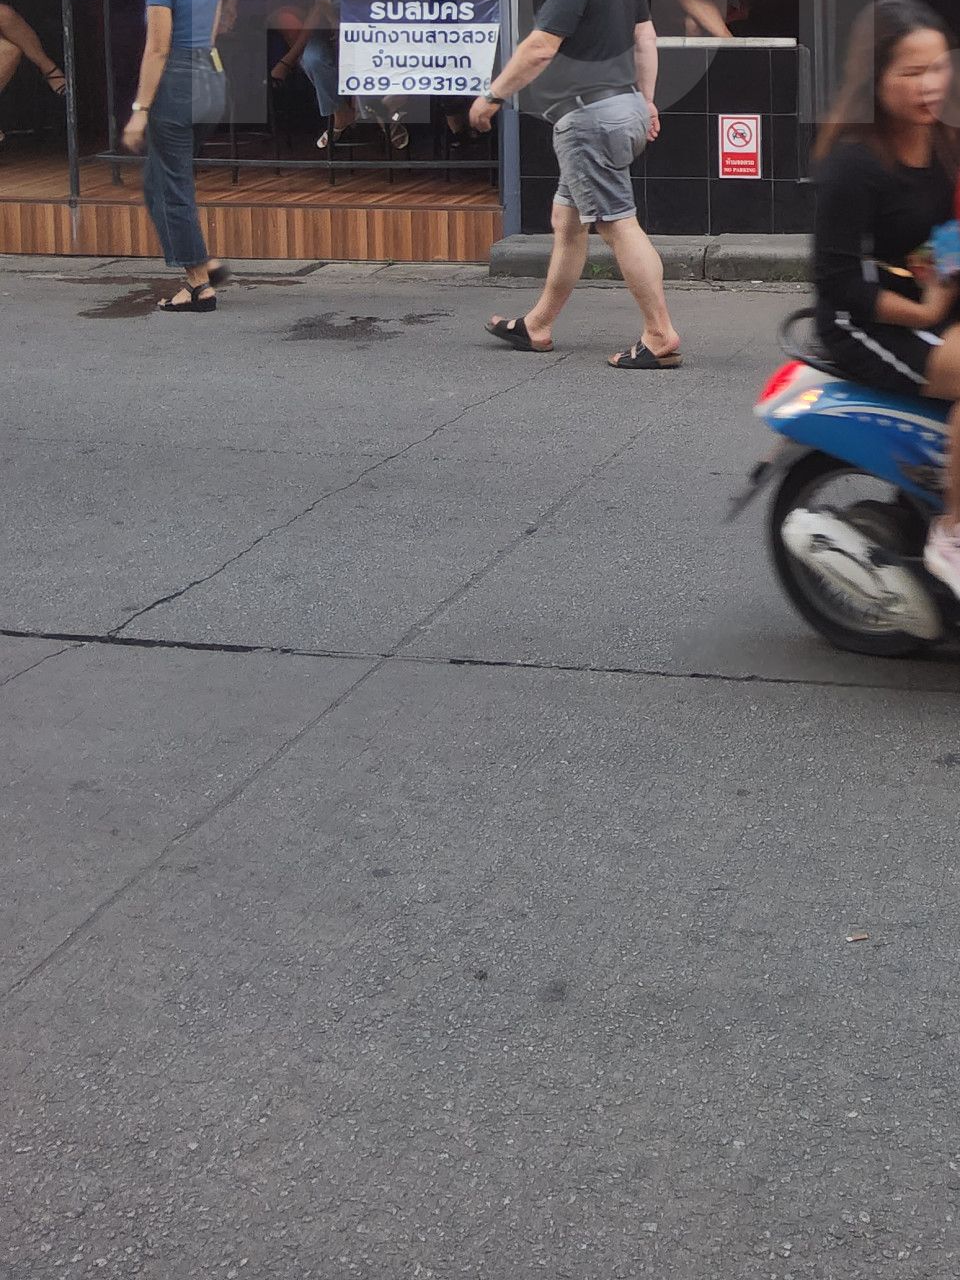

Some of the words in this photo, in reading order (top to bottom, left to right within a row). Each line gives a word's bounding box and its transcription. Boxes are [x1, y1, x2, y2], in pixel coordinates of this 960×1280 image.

[344, 24, 497, 44] พนักงานสาวสวย
[372, 49, 472, 69] จำนวนมาก
